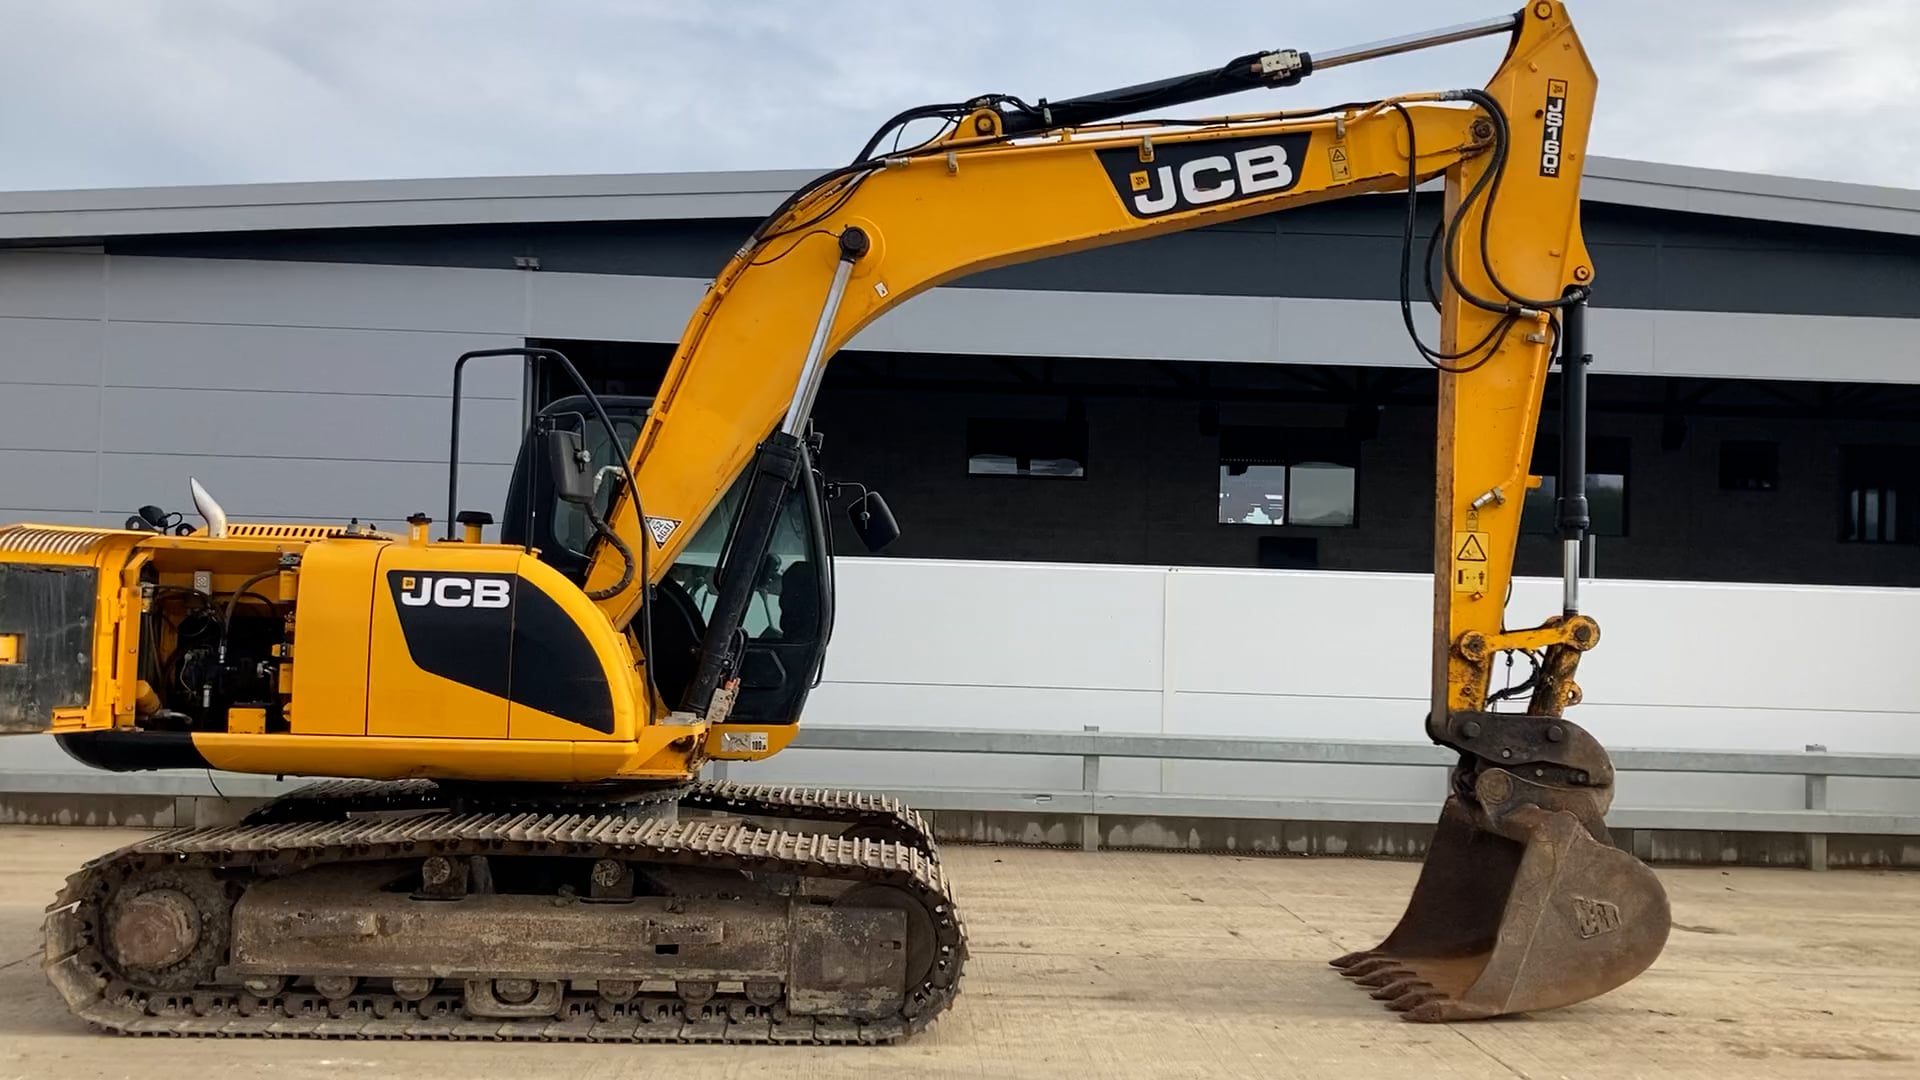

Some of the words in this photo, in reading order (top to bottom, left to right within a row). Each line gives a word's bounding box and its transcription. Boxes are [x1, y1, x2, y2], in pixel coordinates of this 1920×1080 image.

[1543, 99, 1563, 168] JS160
[1134, 144, 1293, 214] JCB
[401, 577, 510, 608] JCB
